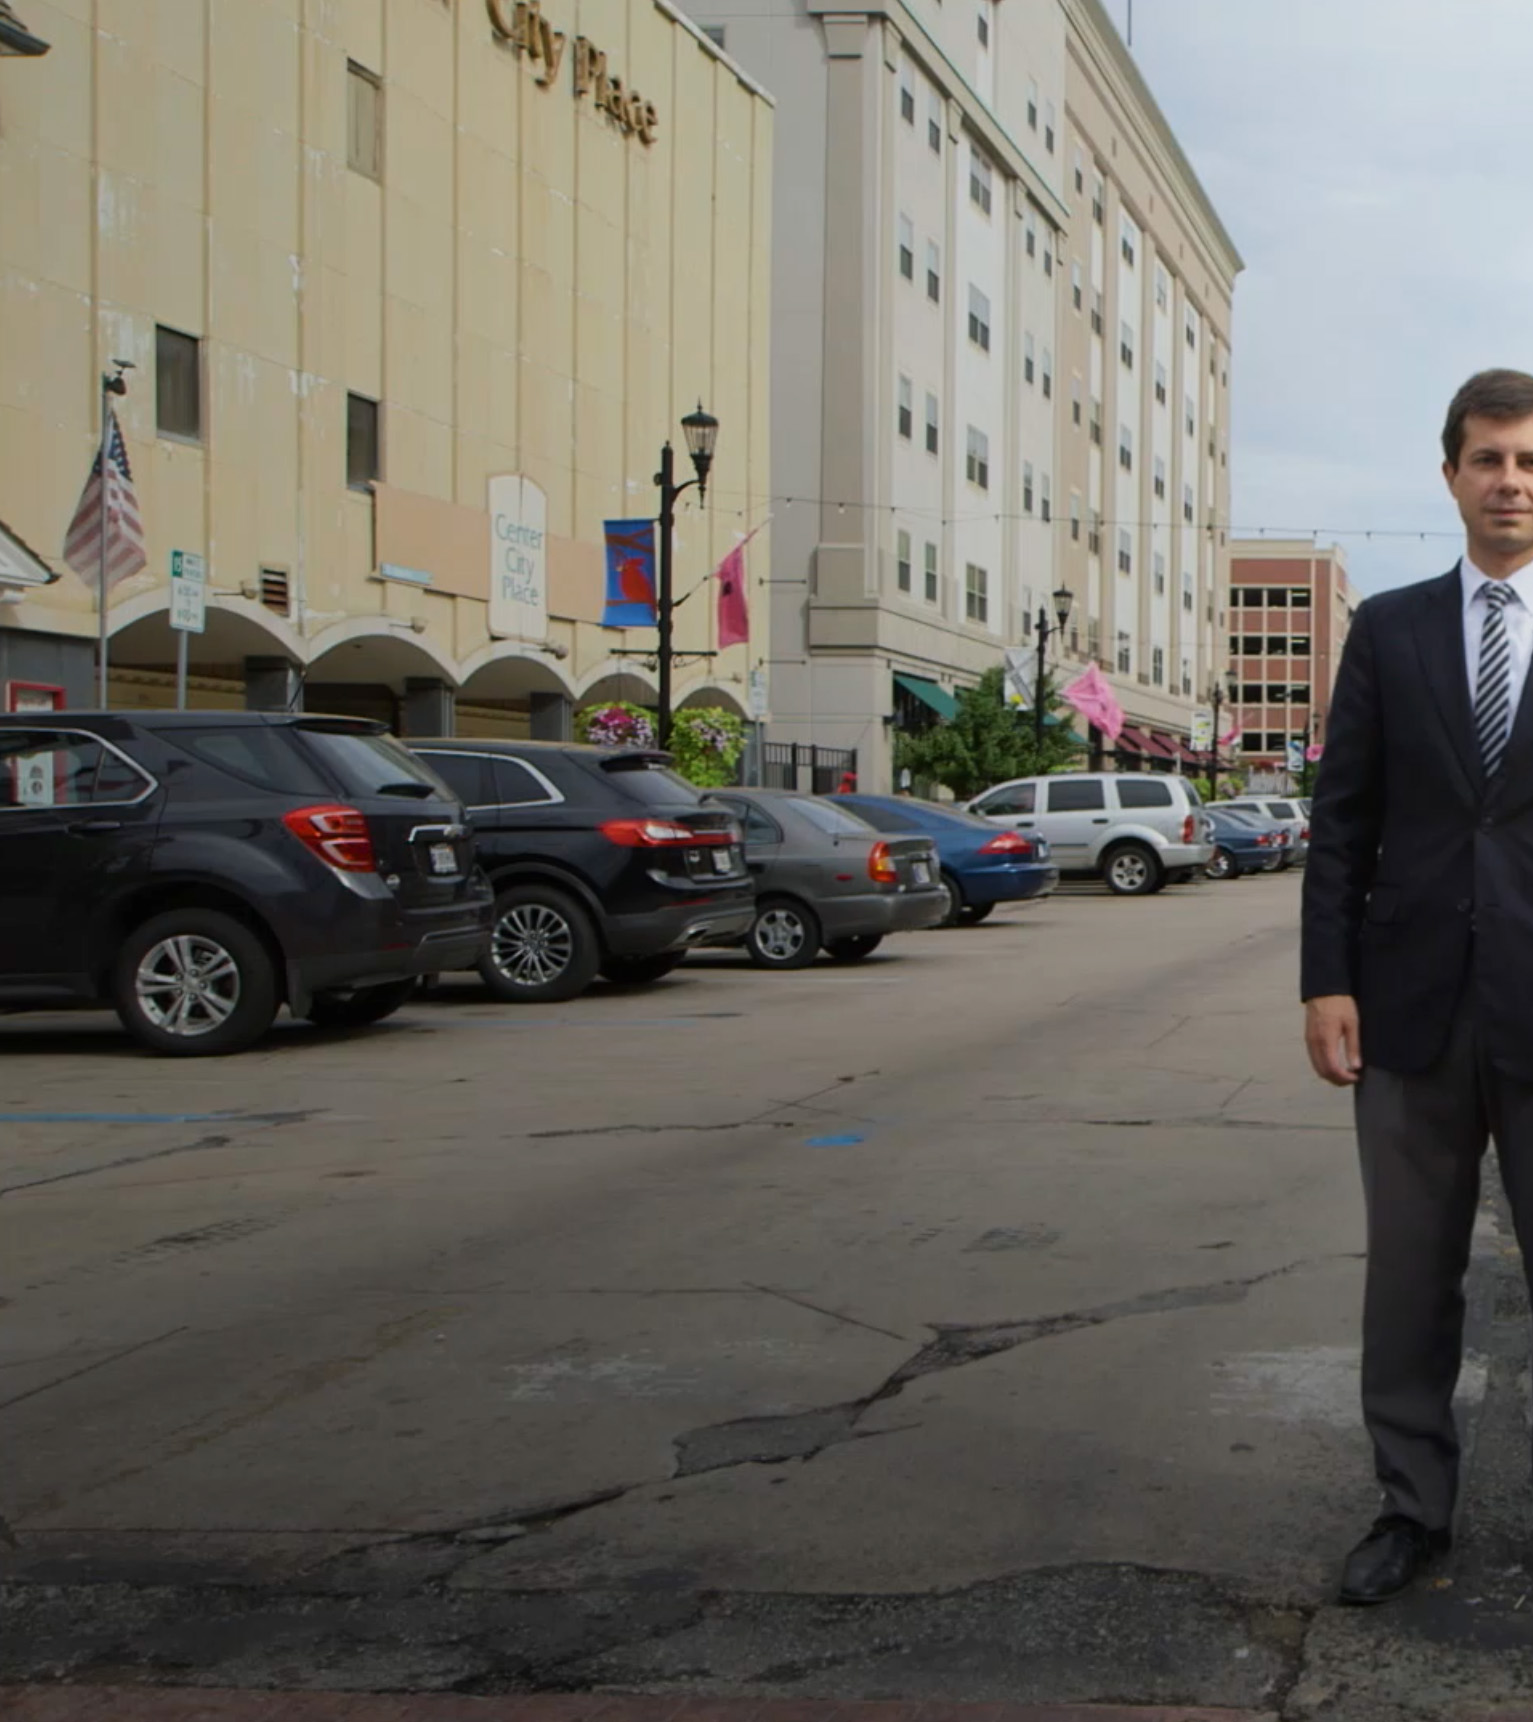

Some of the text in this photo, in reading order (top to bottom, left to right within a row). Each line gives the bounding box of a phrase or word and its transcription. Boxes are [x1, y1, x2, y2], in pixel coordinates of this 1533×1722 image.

[486, 0, 658, 146] City Place
[495, 513, 543, 550] Center
[505, 546, 535, 585] City
[502, 575, 539, 607] Place
